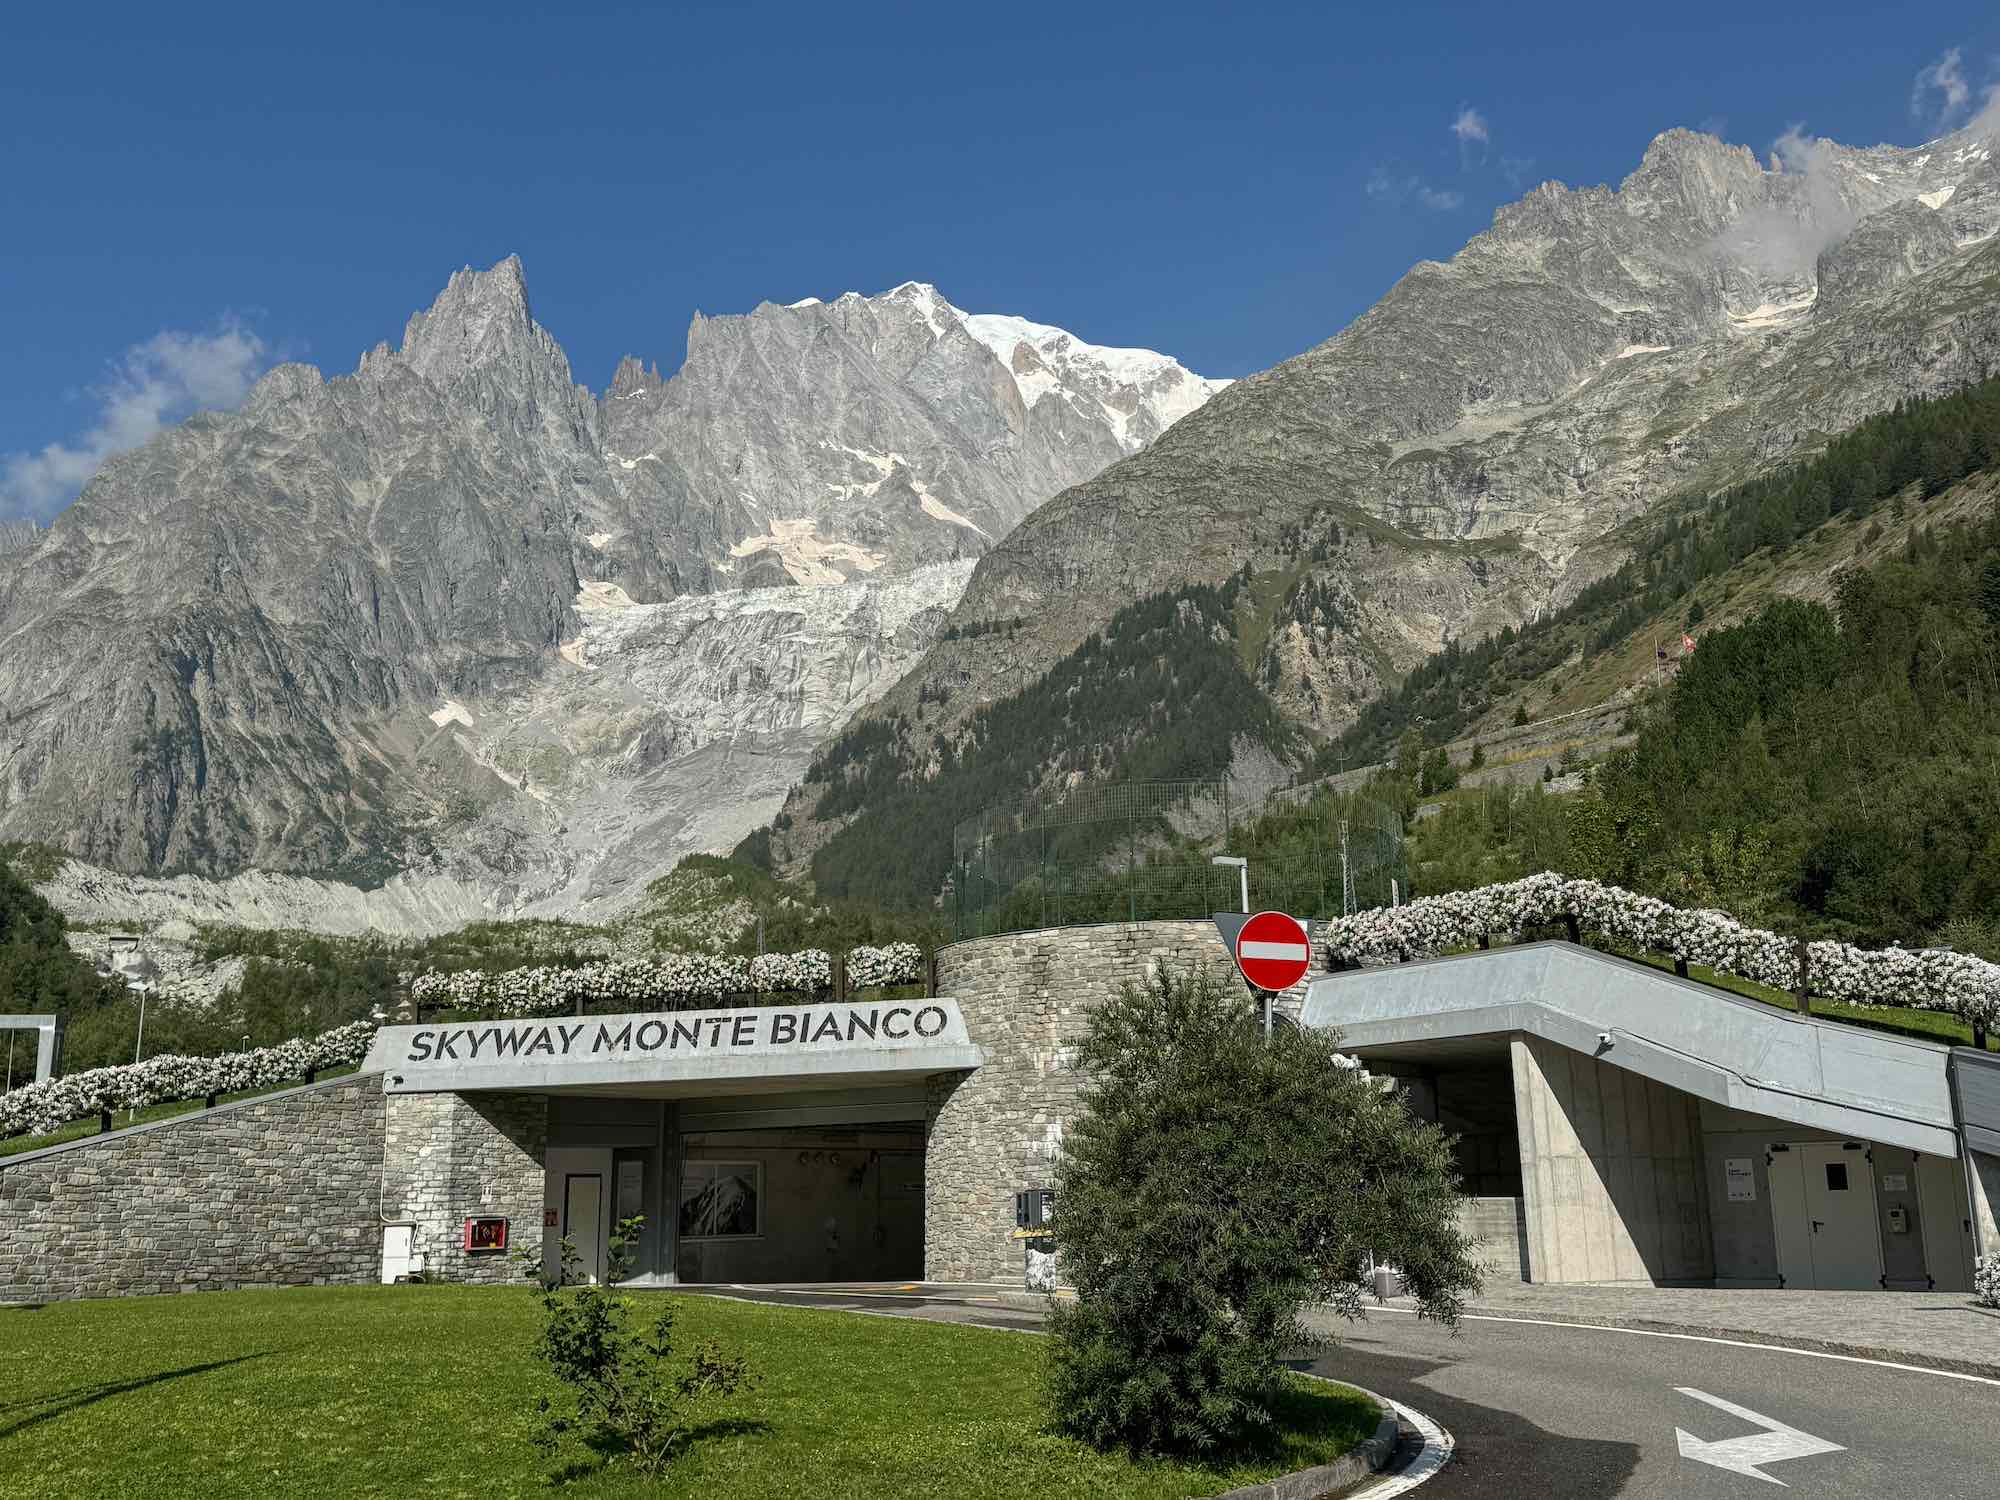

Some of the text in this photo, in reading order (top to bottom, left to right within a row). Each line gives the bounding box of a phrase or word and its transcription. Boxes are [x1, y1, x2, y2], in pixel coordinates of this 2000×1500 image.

[408, 1006, 948, 1062] SKYWAY MONTE BIANCO
